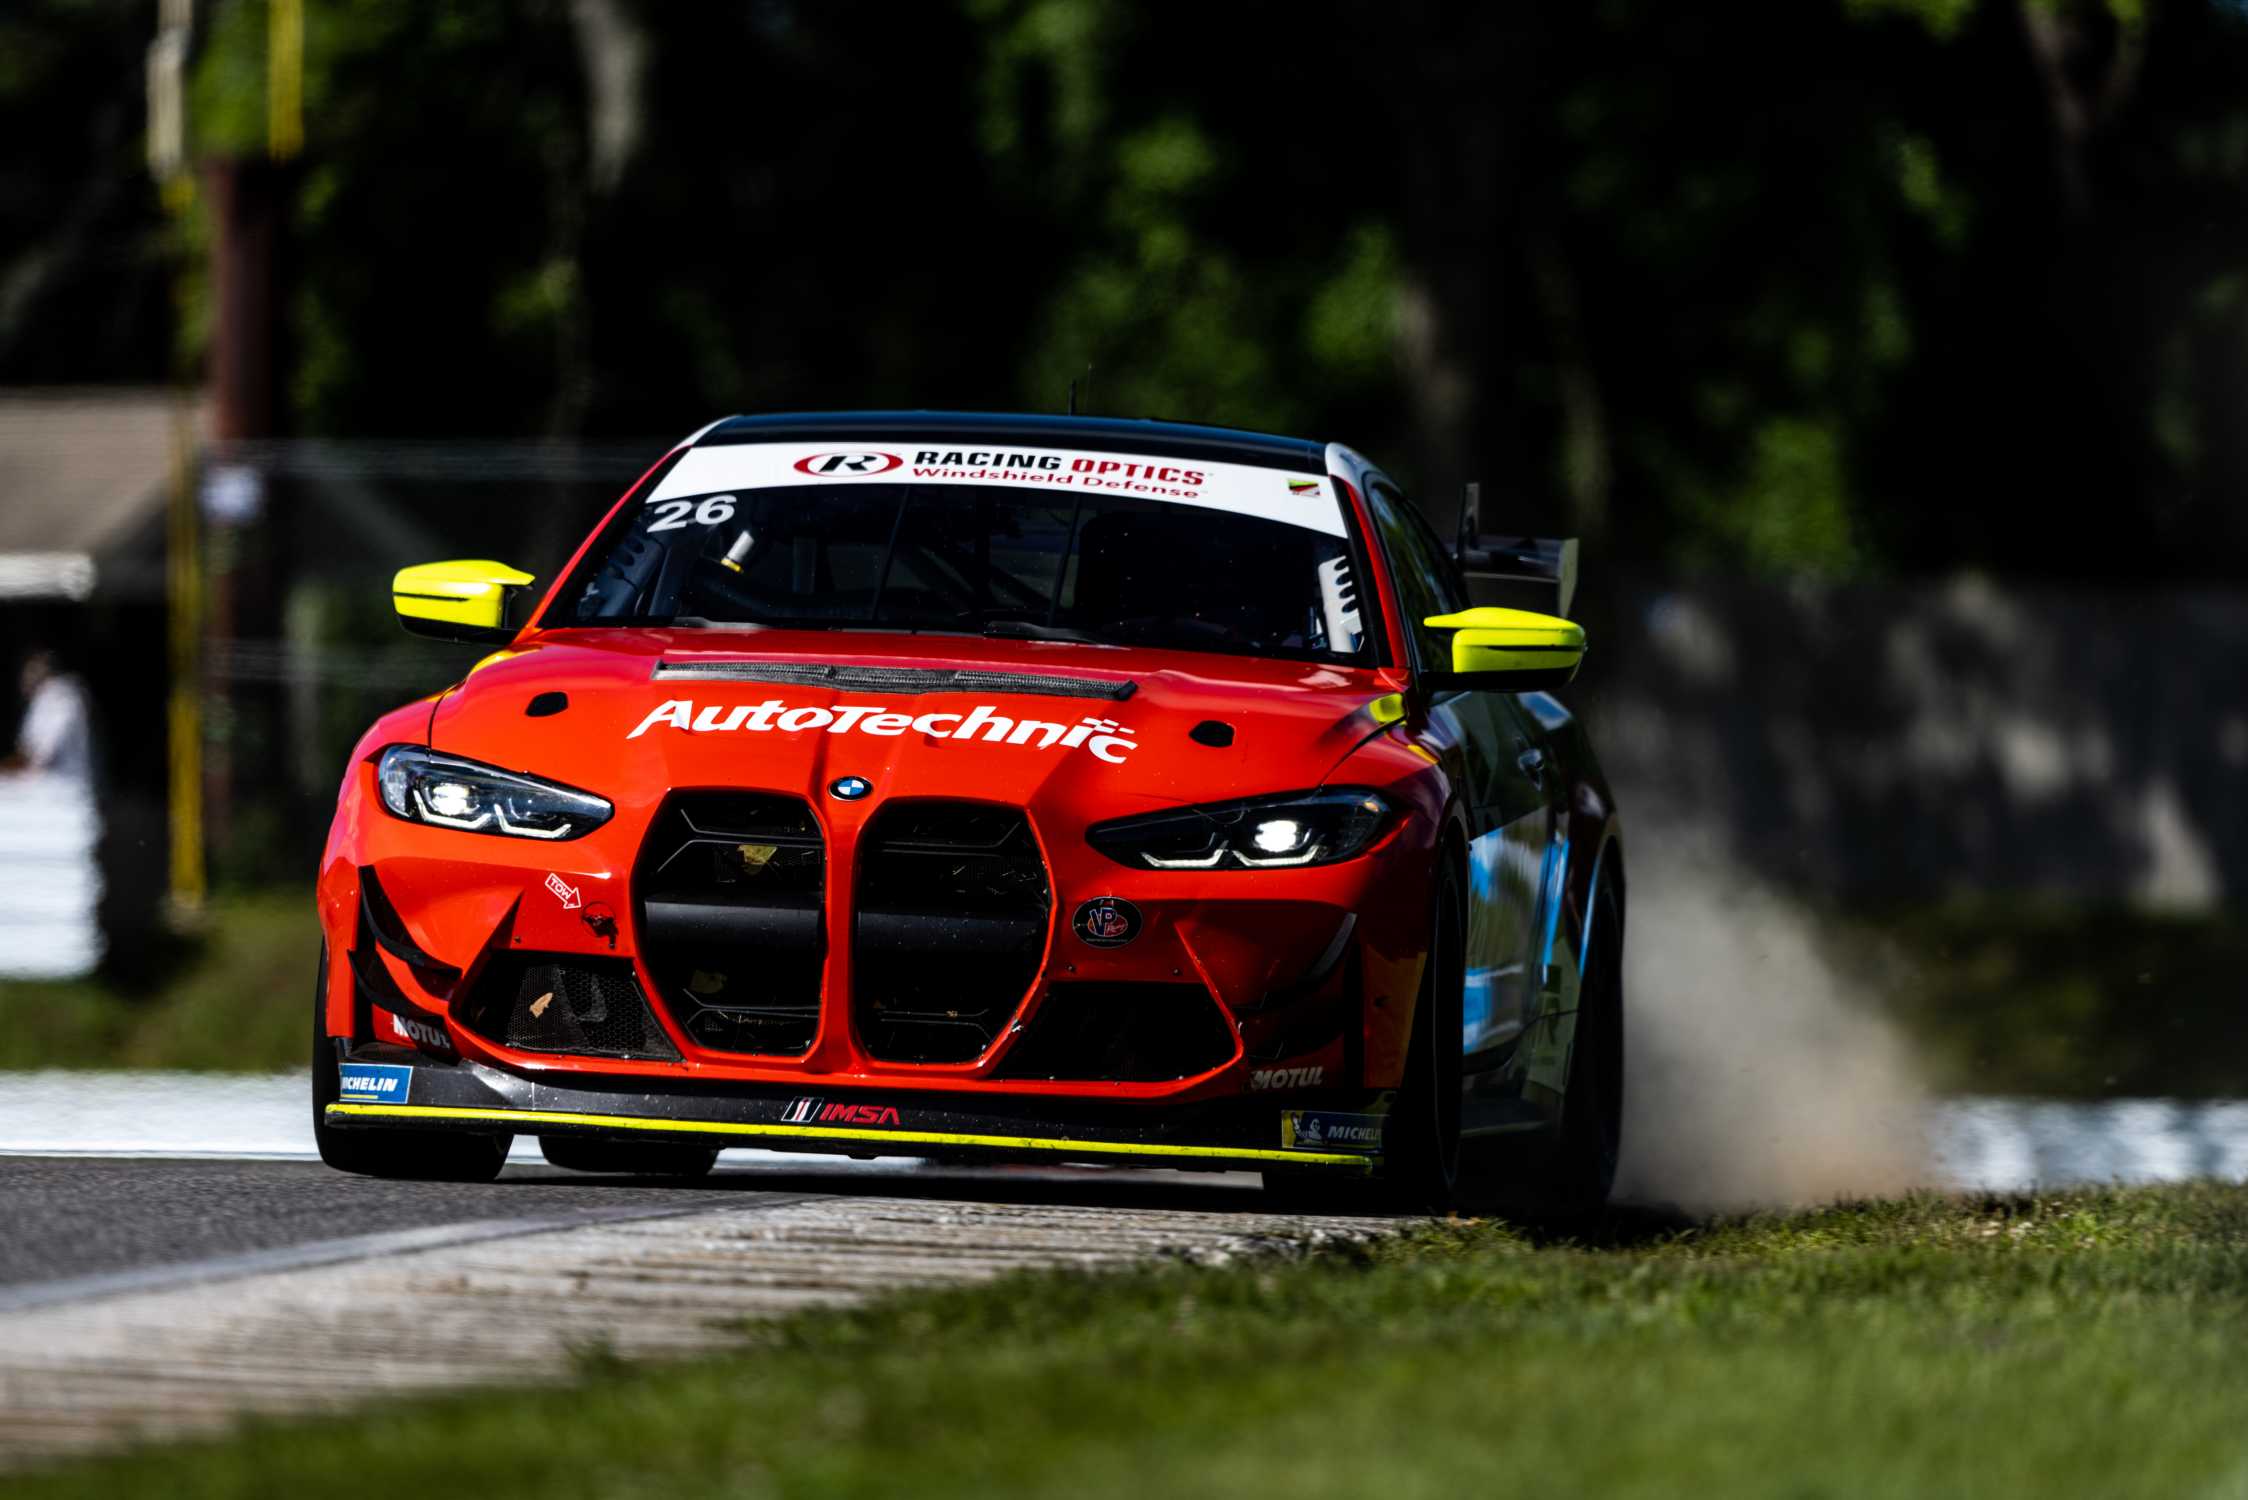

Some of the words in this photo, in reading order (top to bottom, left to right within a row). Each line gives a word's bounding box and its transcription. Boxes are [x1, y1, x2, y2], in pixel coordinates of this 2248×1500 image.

[912, 467, 1074, 485] Windshield
[1083, 476, 1200, 499] Defense
[913, 451, 1062, 471] RACING
[1071, 458, 1205, 486] OPTICS
[645, 493, 738, 534] 26
[626, 698, 1139, 765] AutoTechnic
[549, 876, 573, 900] TOW
[392, 1012, 451, 1050] MOTUL
[1250, 1065, 1324, 1091] MOTUL
[818, 1102, 901, 1126] IMSA
